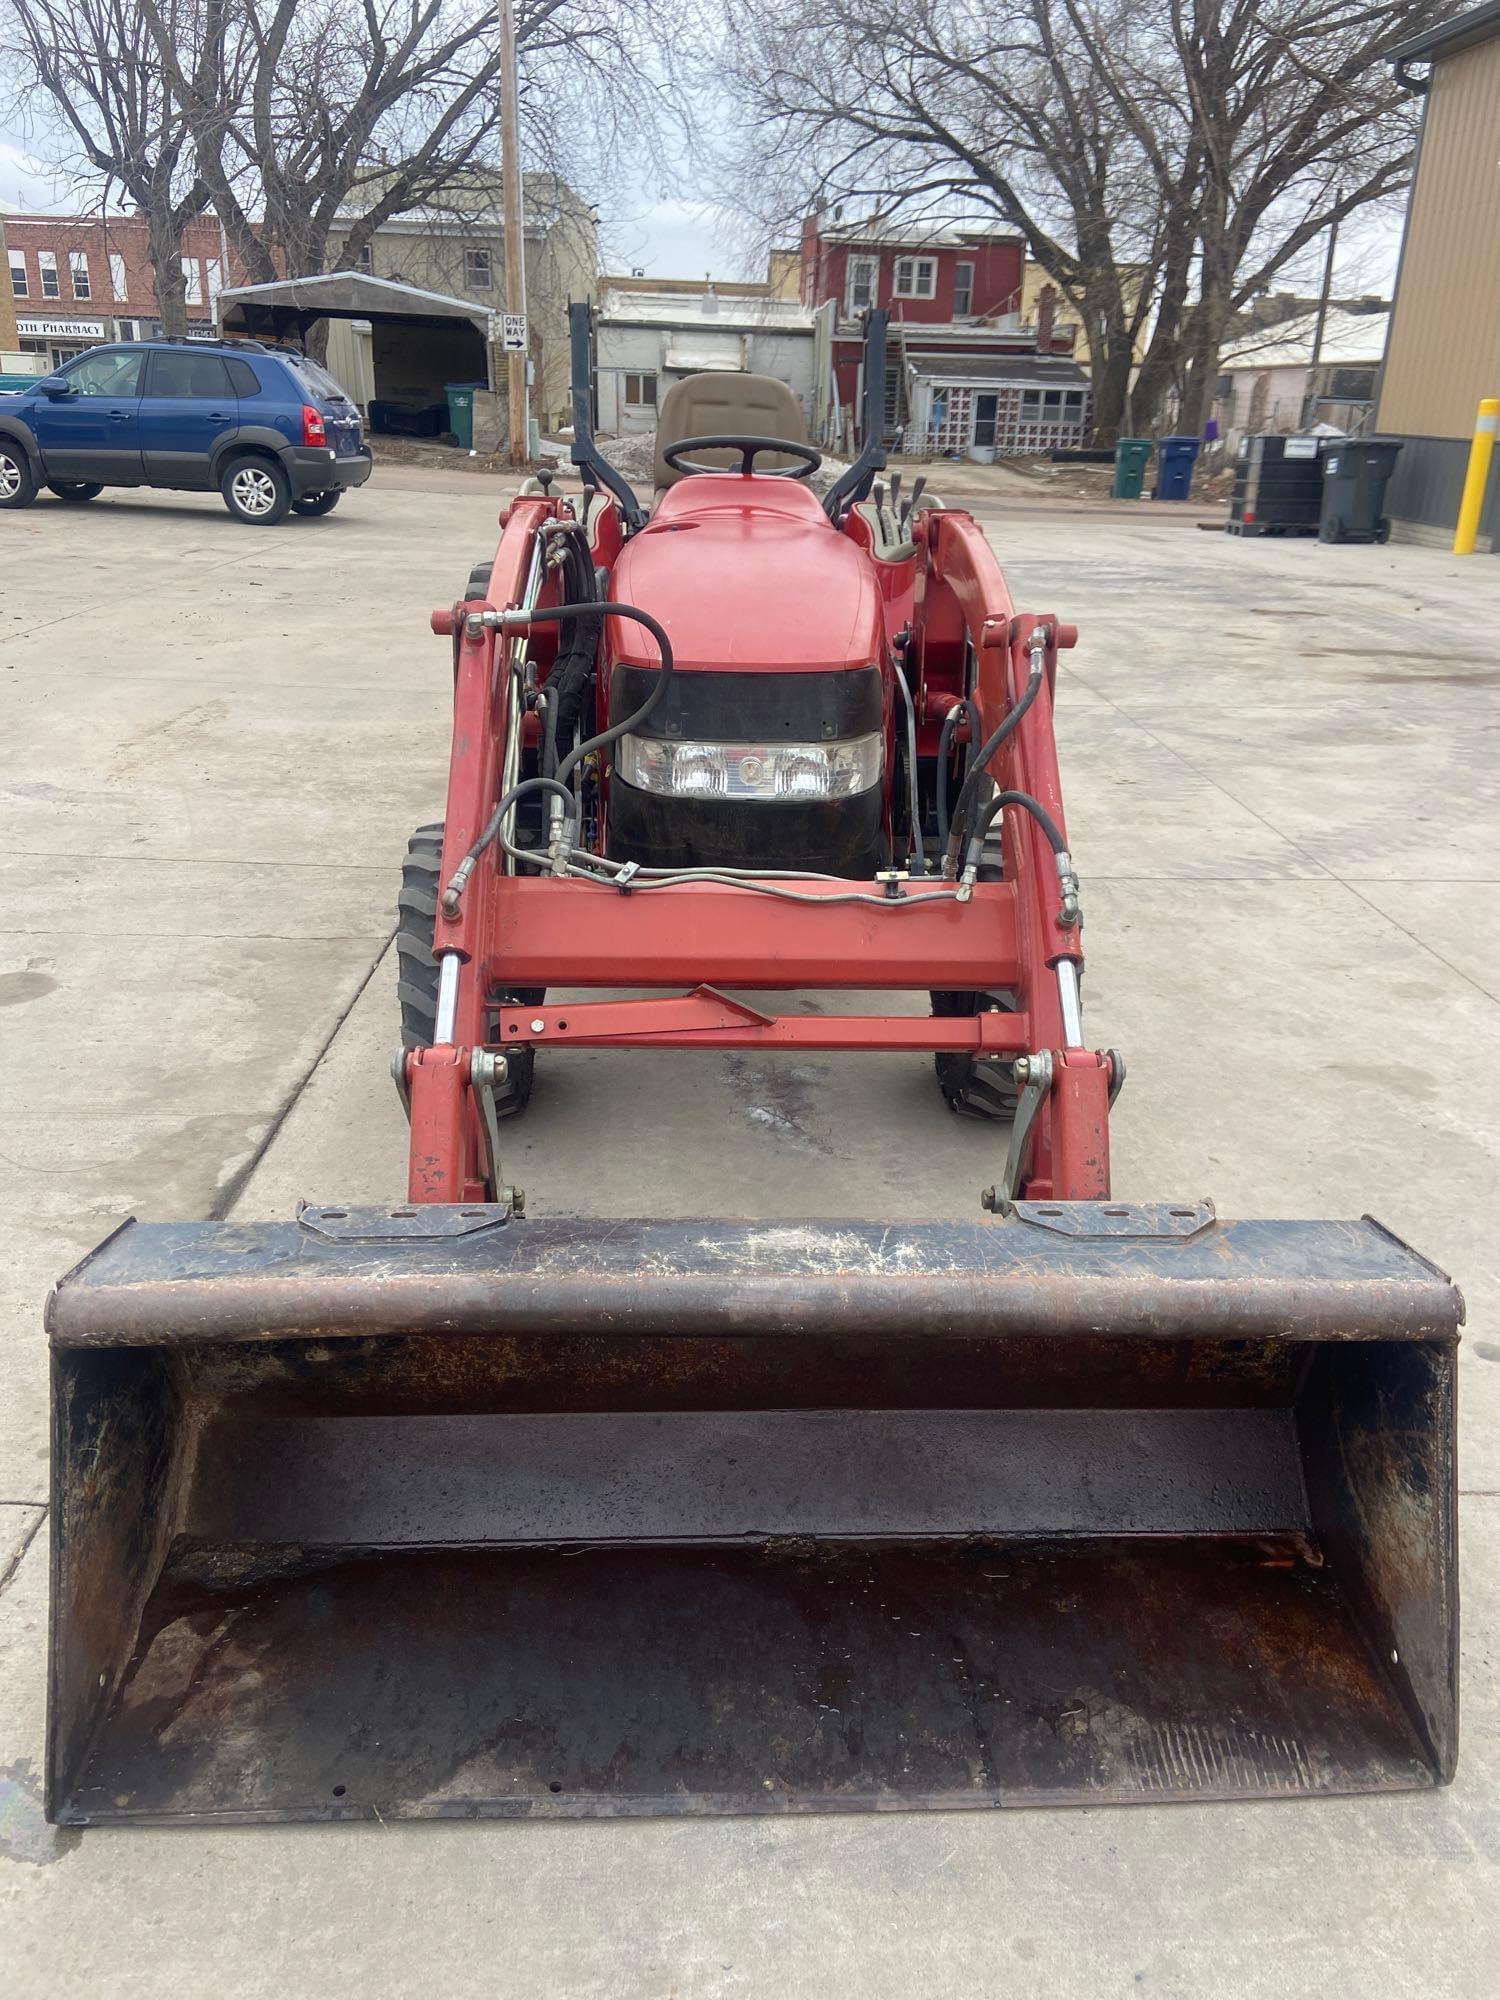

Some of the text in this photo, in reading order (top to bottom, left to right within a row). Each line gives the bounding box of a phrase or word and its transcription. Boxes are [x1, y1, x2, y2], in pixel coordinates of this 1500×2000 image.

[505, 316, 525, 327] ONE
[42, 323, 100, 334] PHARMACY
[505, 327, 525, 336] WAY
